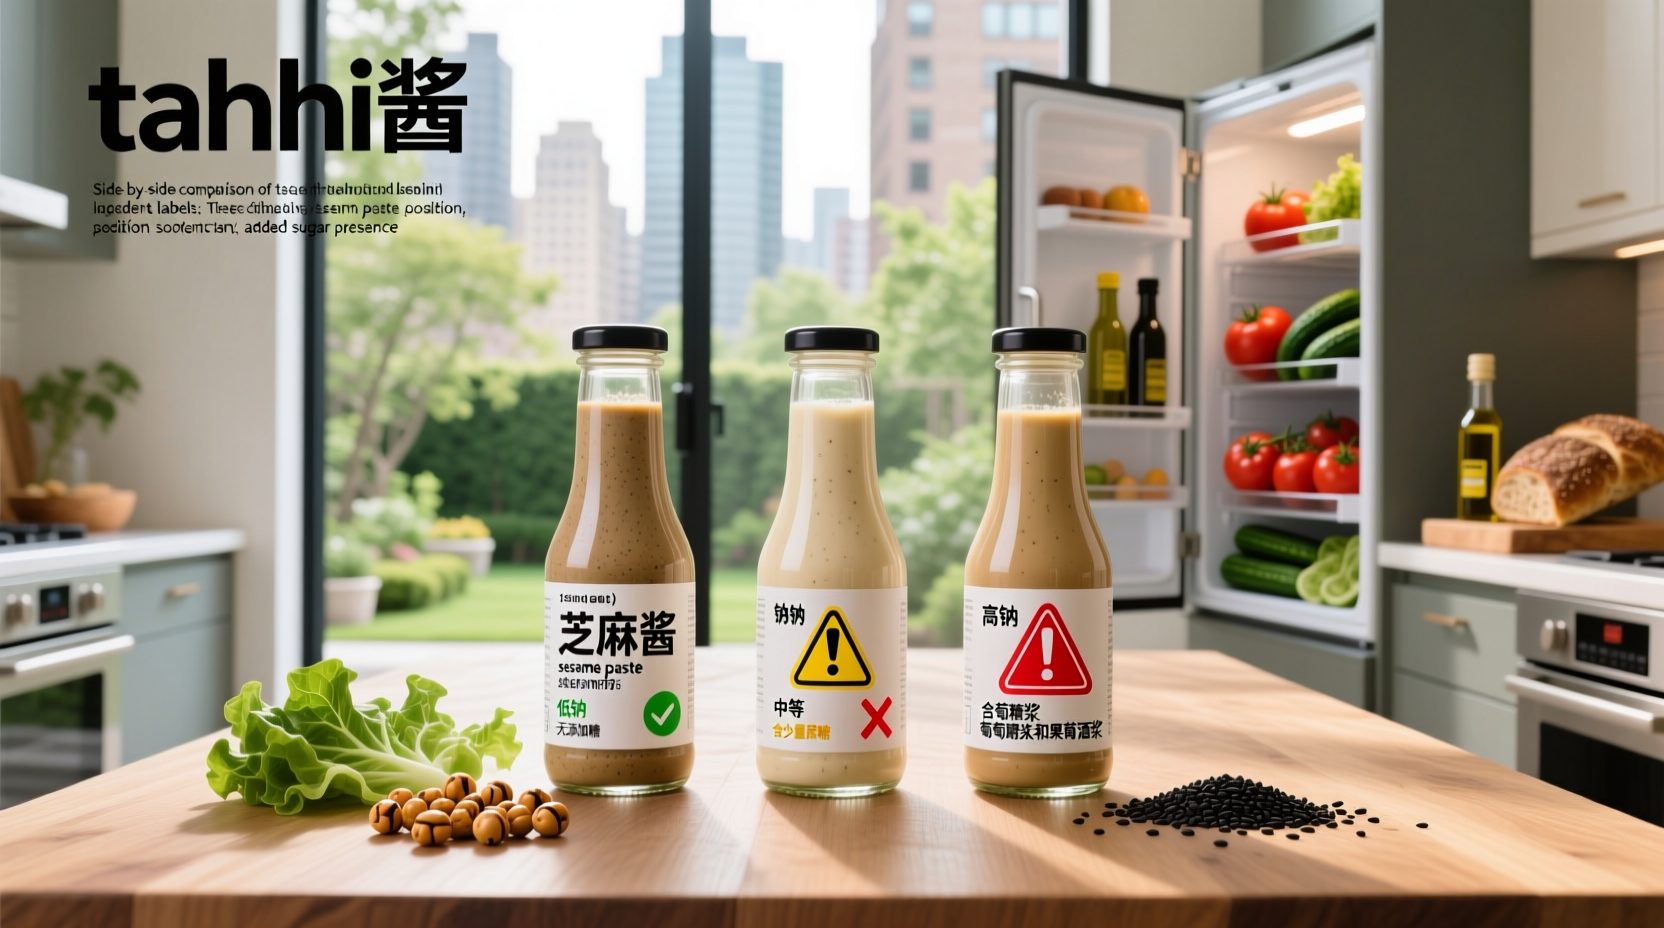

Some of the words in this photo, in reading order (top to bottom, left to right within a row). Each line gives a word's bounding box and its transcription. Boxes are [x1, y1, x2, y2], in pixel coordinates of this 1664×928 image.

[982, 604, 1018, 627] 高钠
[559, 611, 676, 656] 芝麻酱
[558, 663, 601, 674] sesame
[605, 662, 643, 680] paste
[774, 698, 805, 719] 中等
